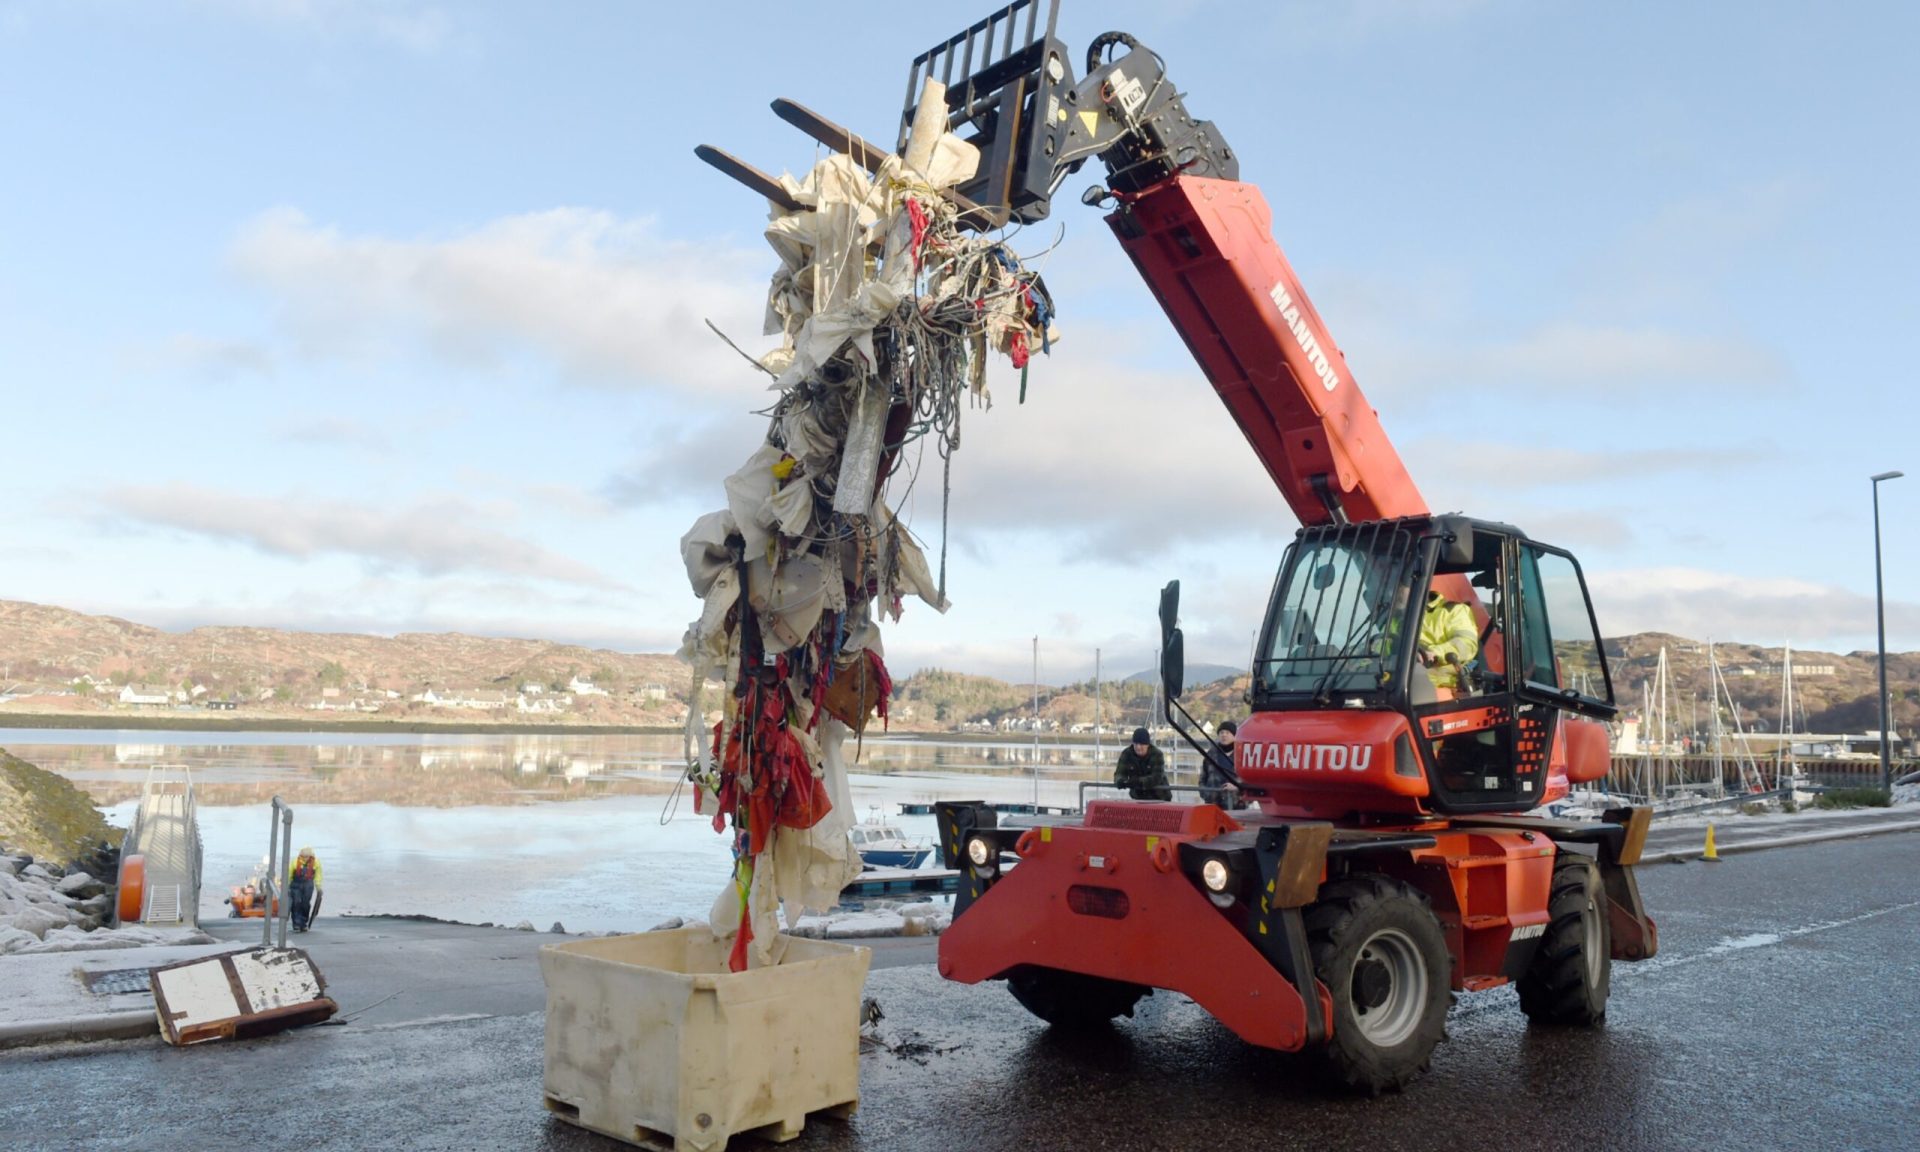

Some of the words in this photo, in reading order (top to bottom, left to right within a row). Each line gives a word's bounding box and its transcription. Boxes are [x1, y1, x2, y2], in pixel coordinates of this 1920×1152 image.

[1270, 281, 1339, 392] MANITOU
[1241, 742, 1373, 771] MANITOU
[1509, 922, 1548, 941] MANITOU
